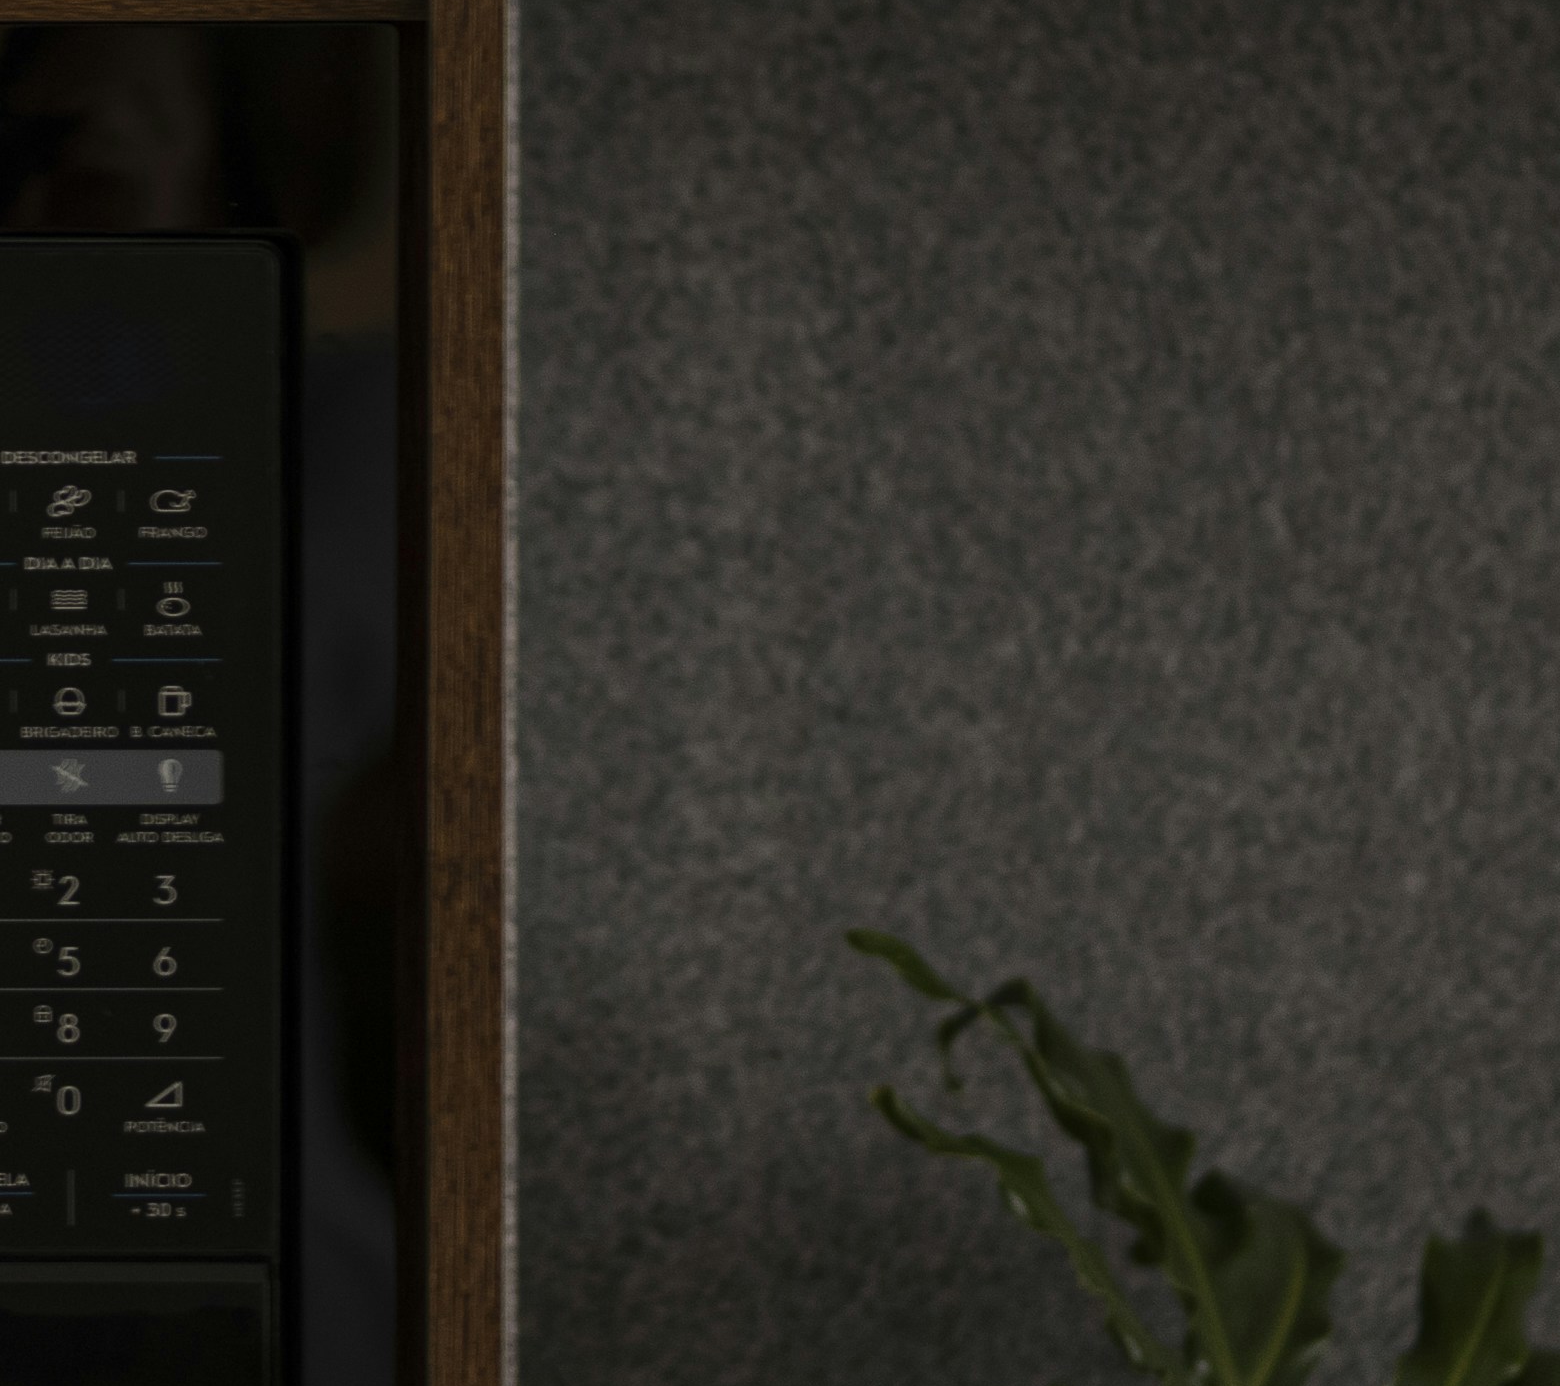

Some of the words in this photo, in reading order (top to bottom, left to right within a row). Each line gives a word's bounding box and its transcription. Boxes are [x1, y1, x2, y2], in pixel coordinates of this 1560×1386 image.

[0, 450, 137, 465] DESCONGELAR
[41, 524, 97, 540] FEIJÃO
[137, 526, 208, 540] FRANGO
[30, 623, 108, 637] LASANHA
[143, 623, 203, 637] BATATA
[46, 652, 92, 667] KIDS
[19, 725, 120, 739] BRIGADEIRO
[147, 725, 217, 739] CANECA
[52, 813, 88, 826] TIRA
[140, 812, 199, 826] DISPLAY
[45, 831, 94, 844] ODOR
[116, 830, 160, 844] AUTO
[161, 830, 225, 844] DESLIGA
[57, 875, 80, 906] 2
[153, 874, 178, 906] 3
[57, 945, 81, 977] 5
[152, 946, 178, 977] 6
[56, 1012, 81, 1044] 8
[153, 1012, 178, 1043] 9
[56, 1084, 82, 1116] 0
[124, 1169, 193, 1189] INÍCIO
